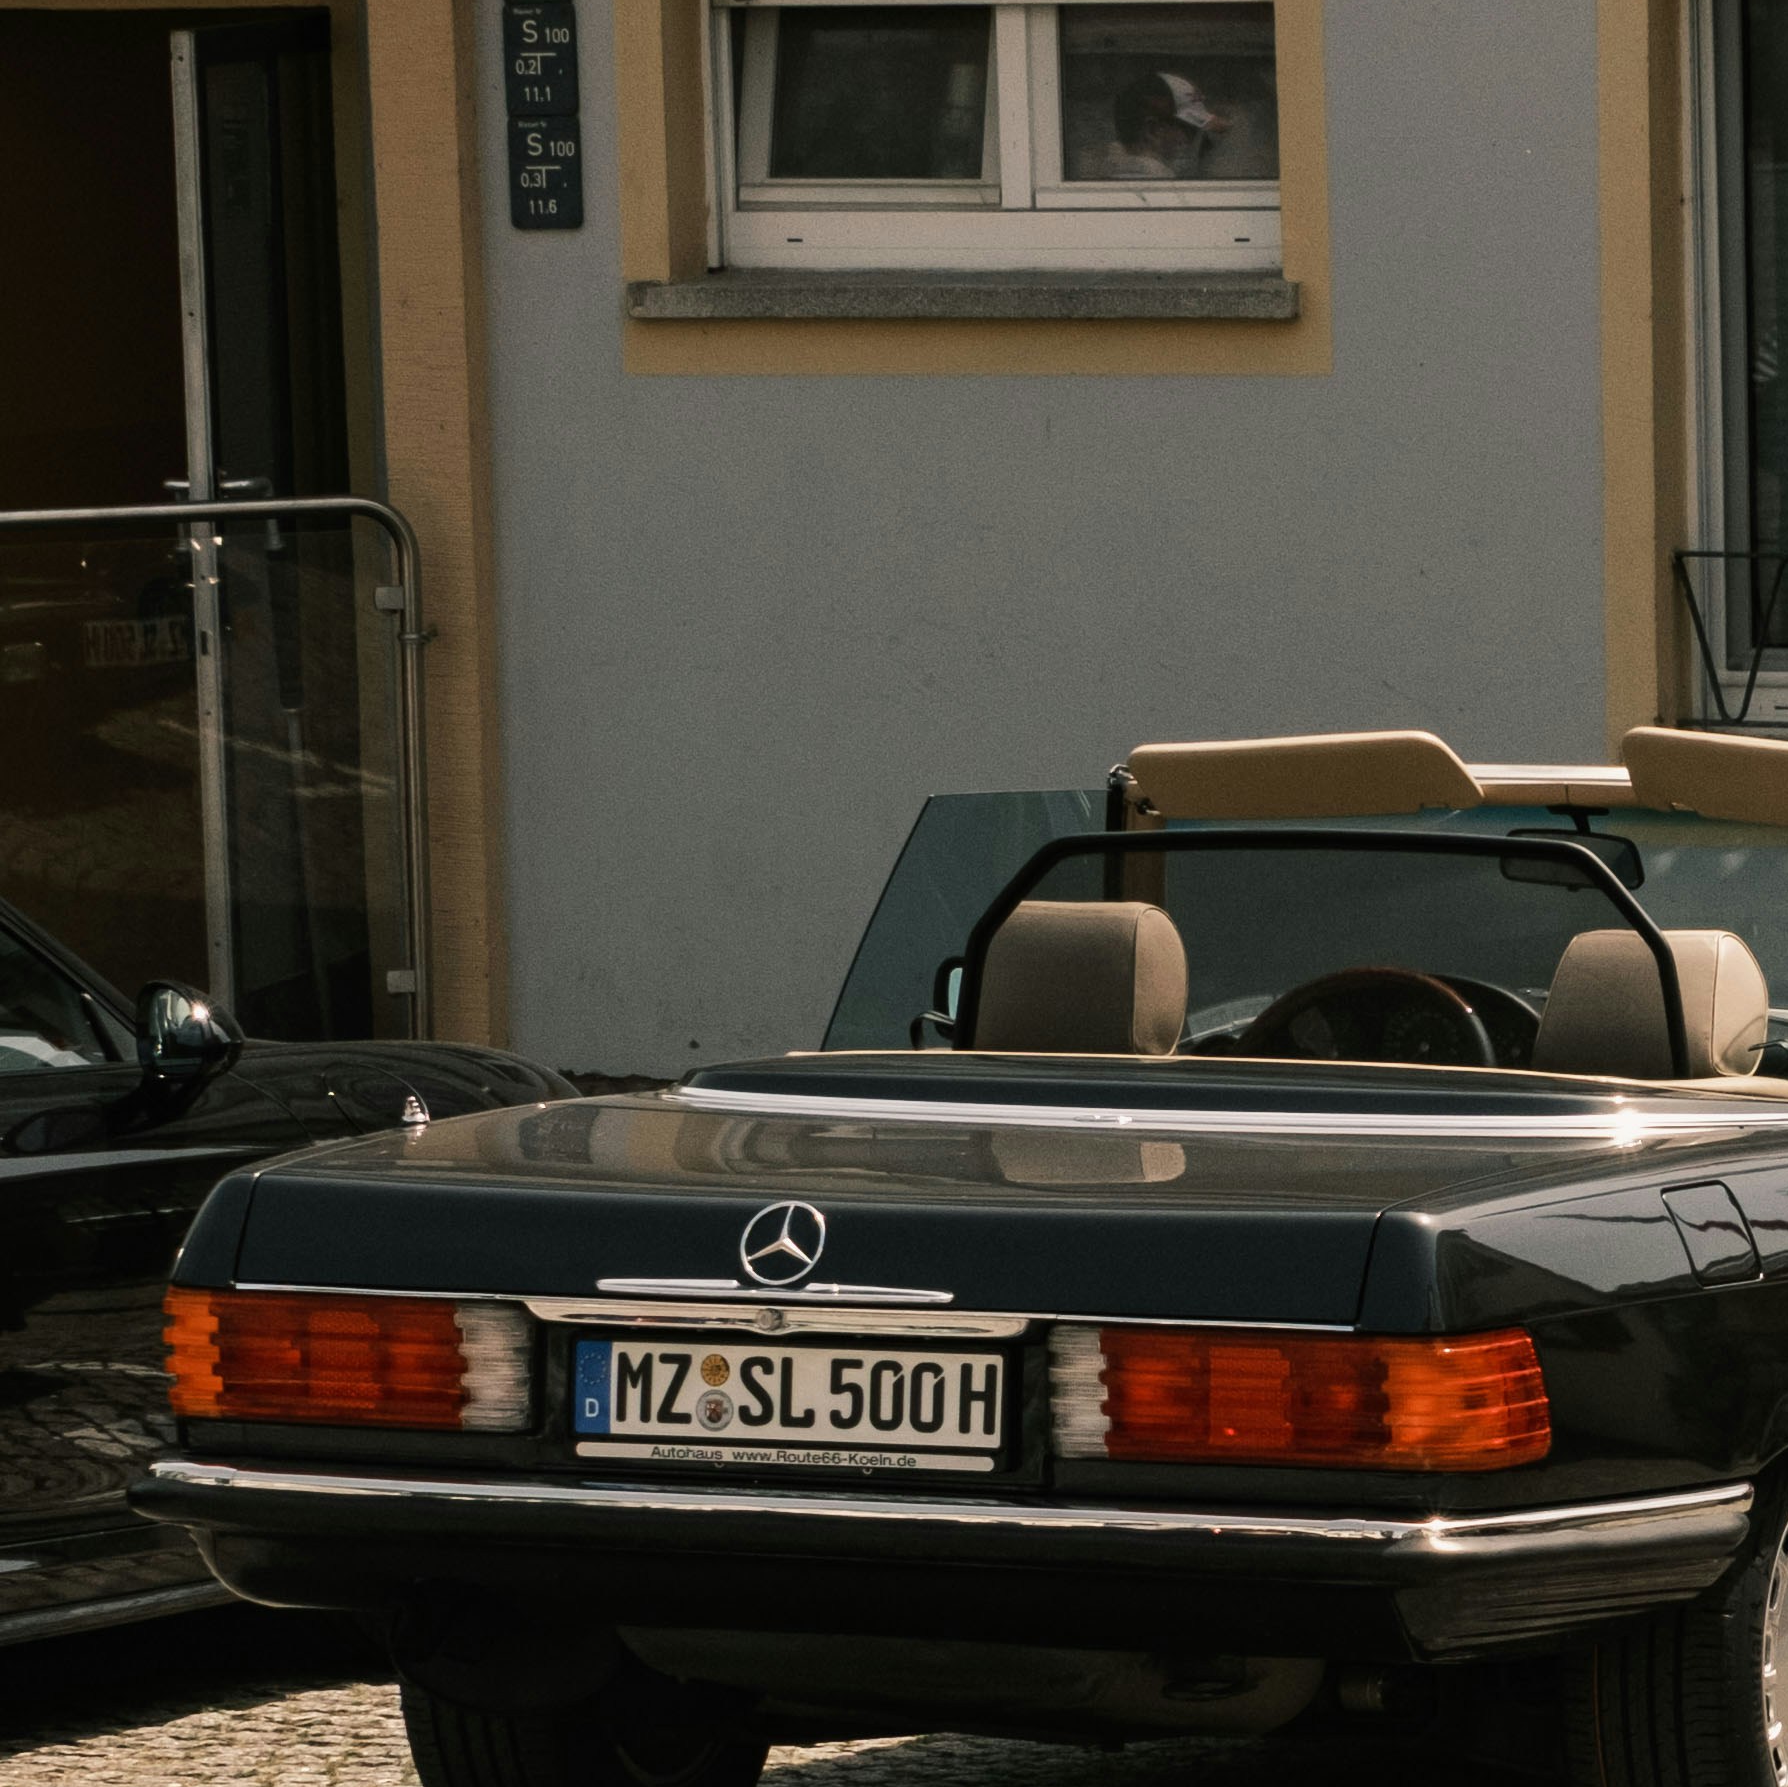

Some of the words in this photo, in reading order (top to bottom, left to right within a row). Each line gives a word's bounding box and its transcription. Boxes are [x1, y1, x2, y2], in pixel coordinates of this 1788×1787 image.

[522, 19, 538, 43] S
[545, 27, 569, 44] 100
[527, 132, 543, 156] S
[549, 141, 575, 157] 100
[616, 1351, 692, 1424] MZ
[738, 1356, 815, 1428] SL
[585, 1398, 599, 1418] D
[651, 1445, 723, 1460] Autohaus
[732, 1449, 917, 1467] www.Route66-Koeln.de
